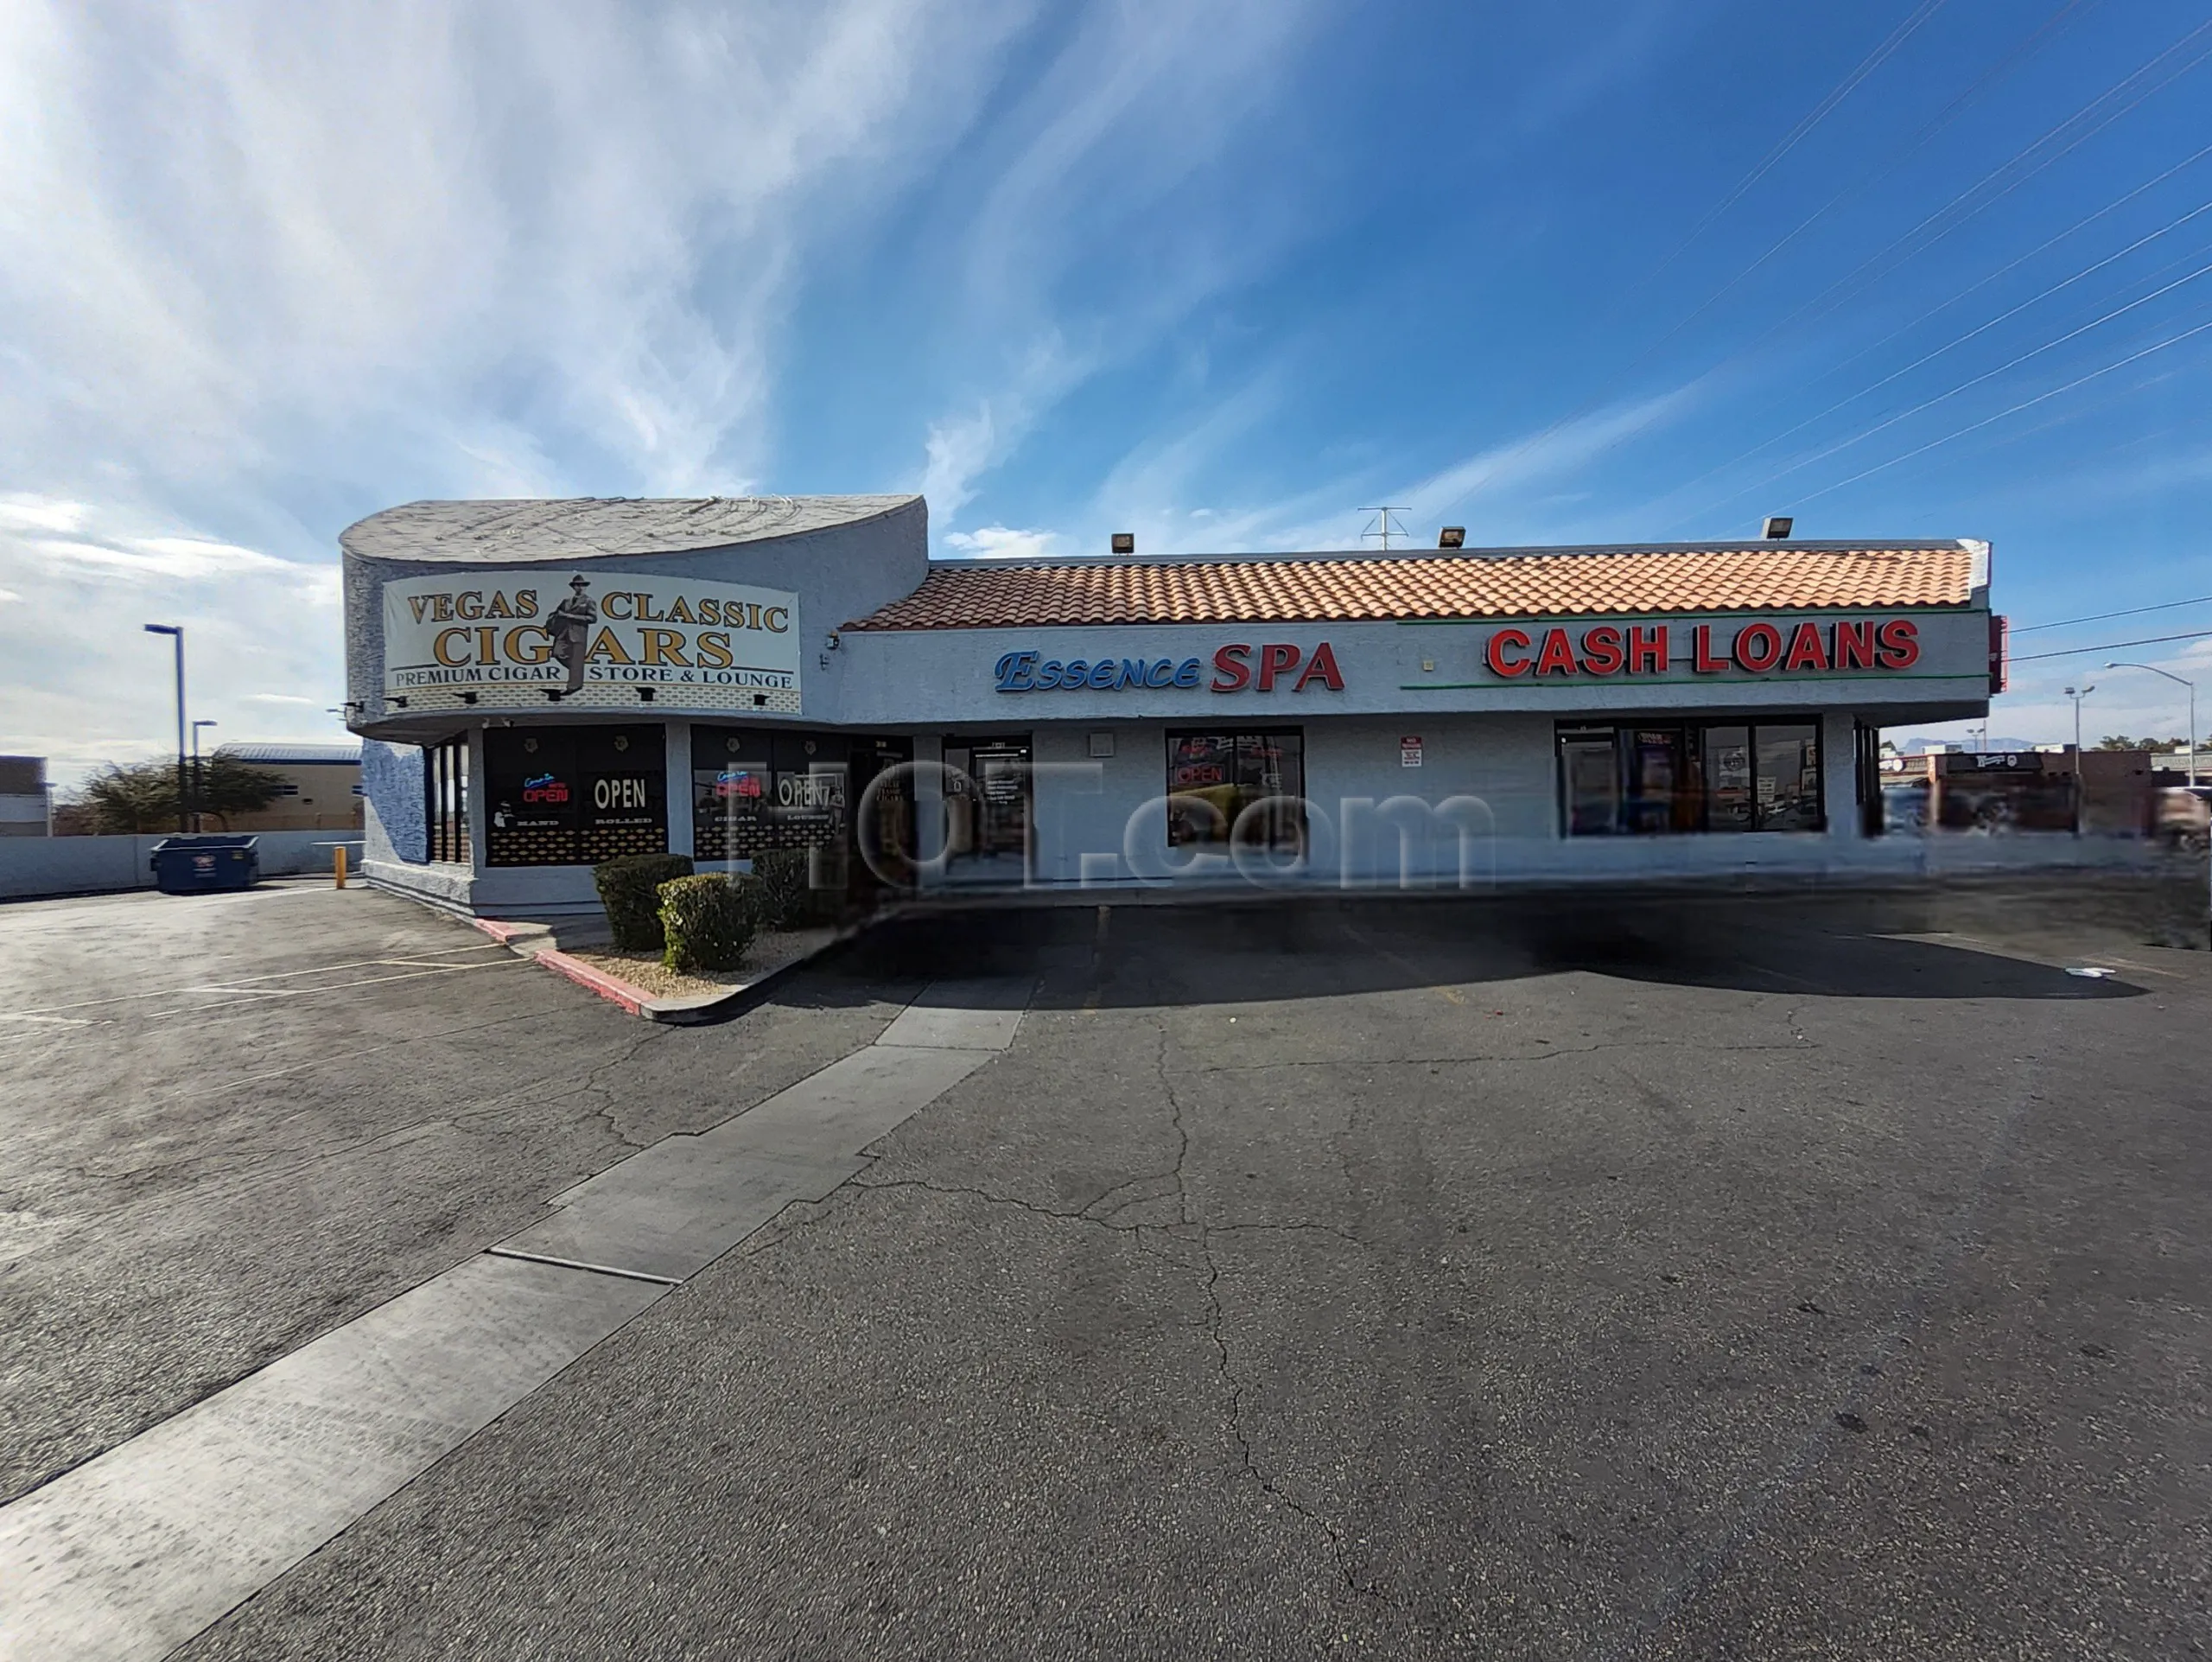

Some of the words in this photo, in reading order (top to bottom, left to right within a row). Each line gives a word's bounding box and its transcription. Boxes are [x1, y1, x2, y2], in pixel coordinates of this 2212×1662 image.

[408, 589, 539, 624] VEGAS
[601, 591, 789, 633] CLASSIC
[433, 624, 734, 670] CIGARS
[1486, 625, 1669, 678] CASH
[1693, 620, 1921, 672] LOANS
[397, 668, 482, 687] PREMIUM
[488, 666, 561, 681] CIGAR
[589, 666, 673, 682] STORE
[680, 670, 695, 683] &
[703, 671, 793, 689] LOUNGE
[1210, 641, 1345, 692] SPA
[1178, 767, 1223, 781] OPEN
[524, 789, 569, 803] OPEN
[594, 779, 646, 810] OPEN
[715, 782, 761, 797] OPEN
[779, 778, 823, 806] OPEN
